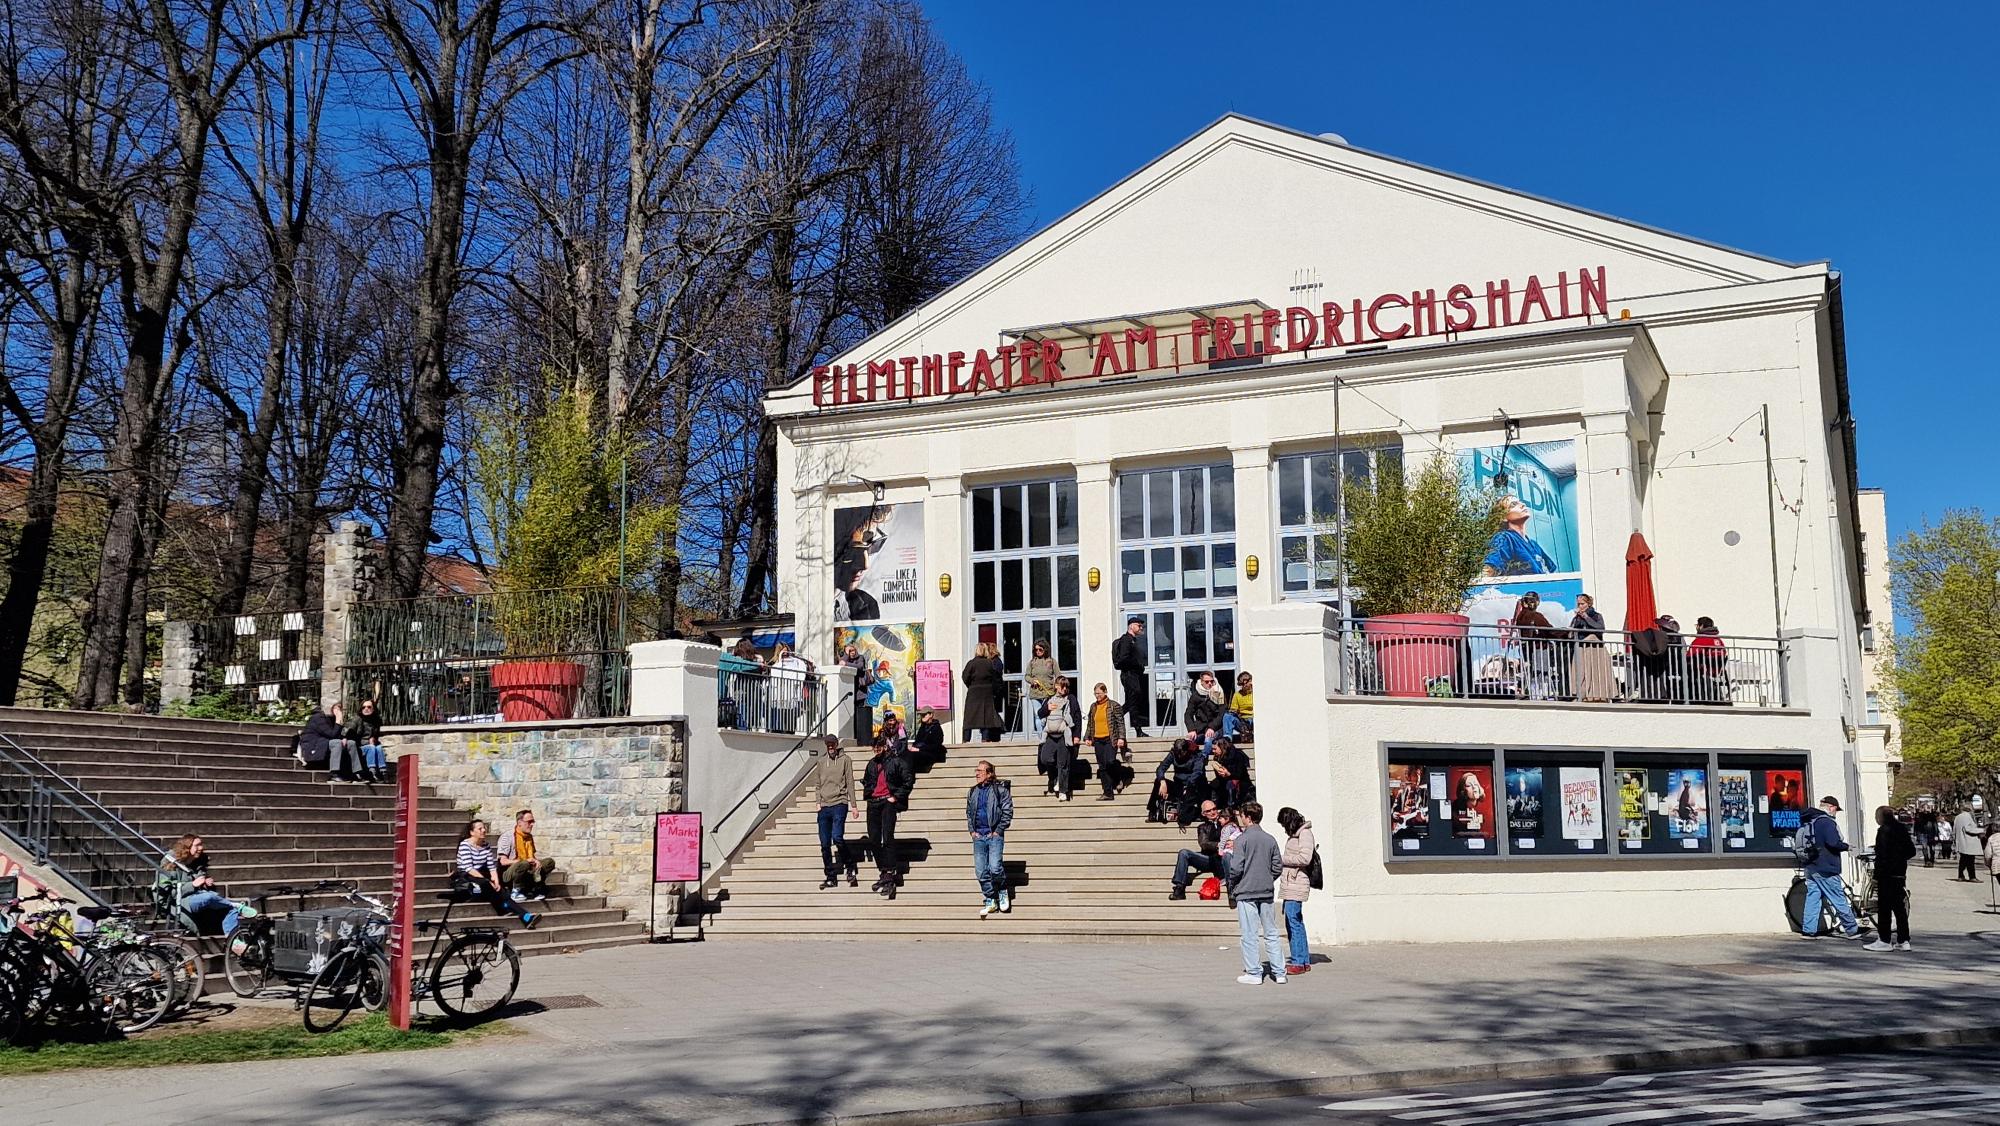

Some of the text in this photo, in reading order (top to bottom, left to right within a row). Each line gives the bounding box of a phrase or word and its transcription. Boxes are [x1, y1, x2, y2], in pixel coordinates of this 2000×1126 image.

[813, 265, 1608, 407] FILMTHEATER AM FRIEDRICHSHAIN
[895, 568, 917, 580] LIKE A
[883, 580, 918, 592] COMPLETE
[882, 590, 918, 604] UNKNOWN
[924, 670, 949, 679] Markt
[659, 815, 679, 828] FAF
[1509, 820, 1538, 828] DAS LICHT
[1674, 818, 1700, 833] Flow
[668, 826, 698, 837] Markt
